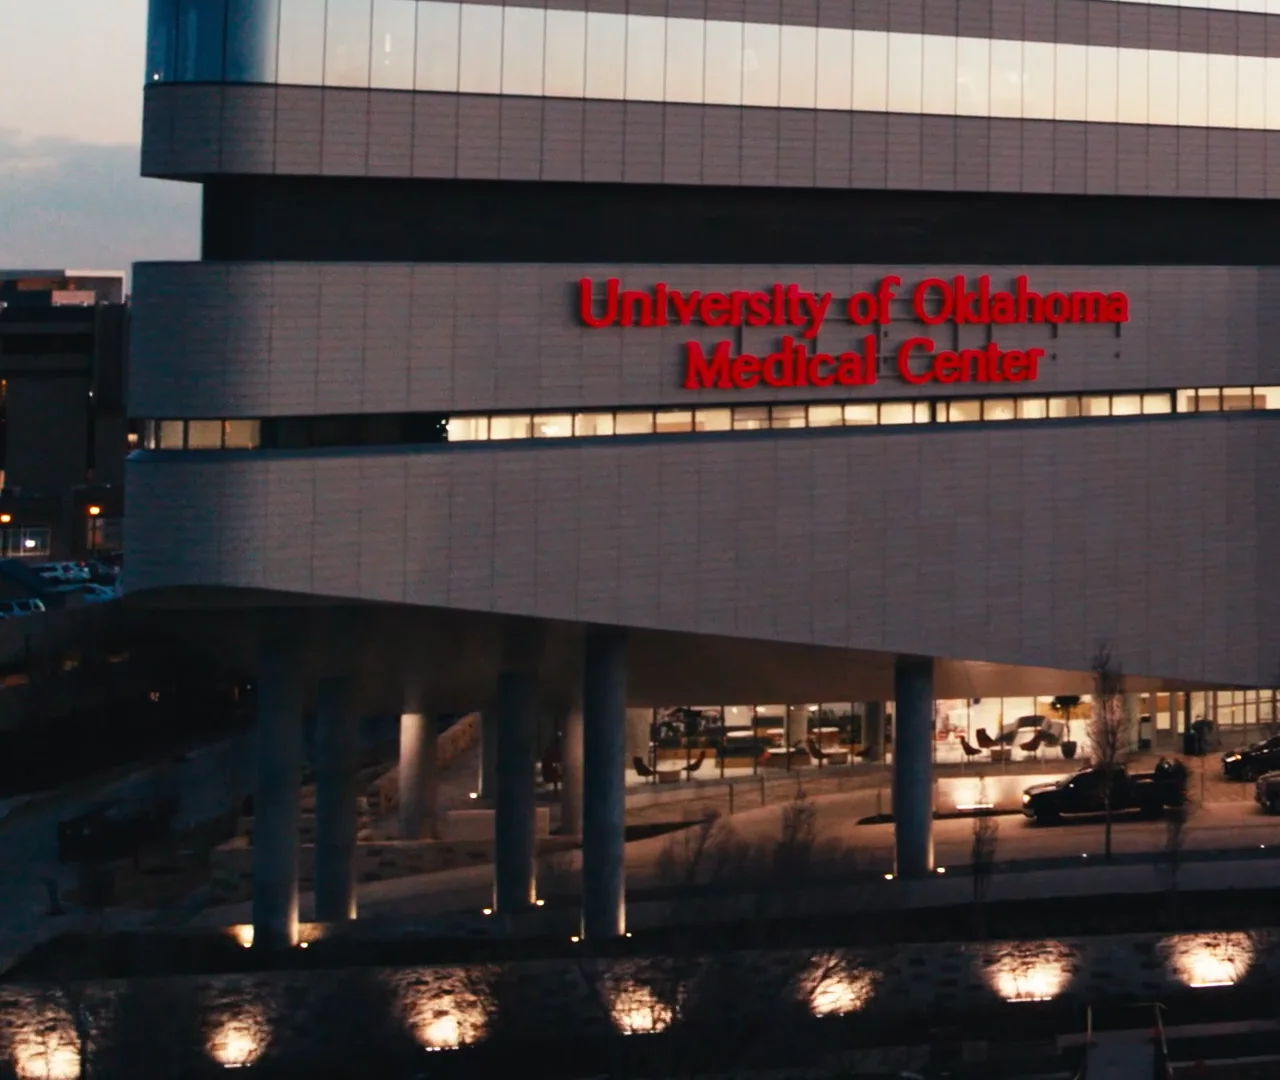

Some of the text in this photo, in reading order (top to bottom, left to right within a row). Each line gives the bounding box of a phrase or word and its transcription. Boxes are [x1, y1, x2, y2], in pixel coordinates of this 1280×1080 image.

[578, 274, 1131, 340] University of Oklahoma
[684, 334, 1047, 390] Medical Center
